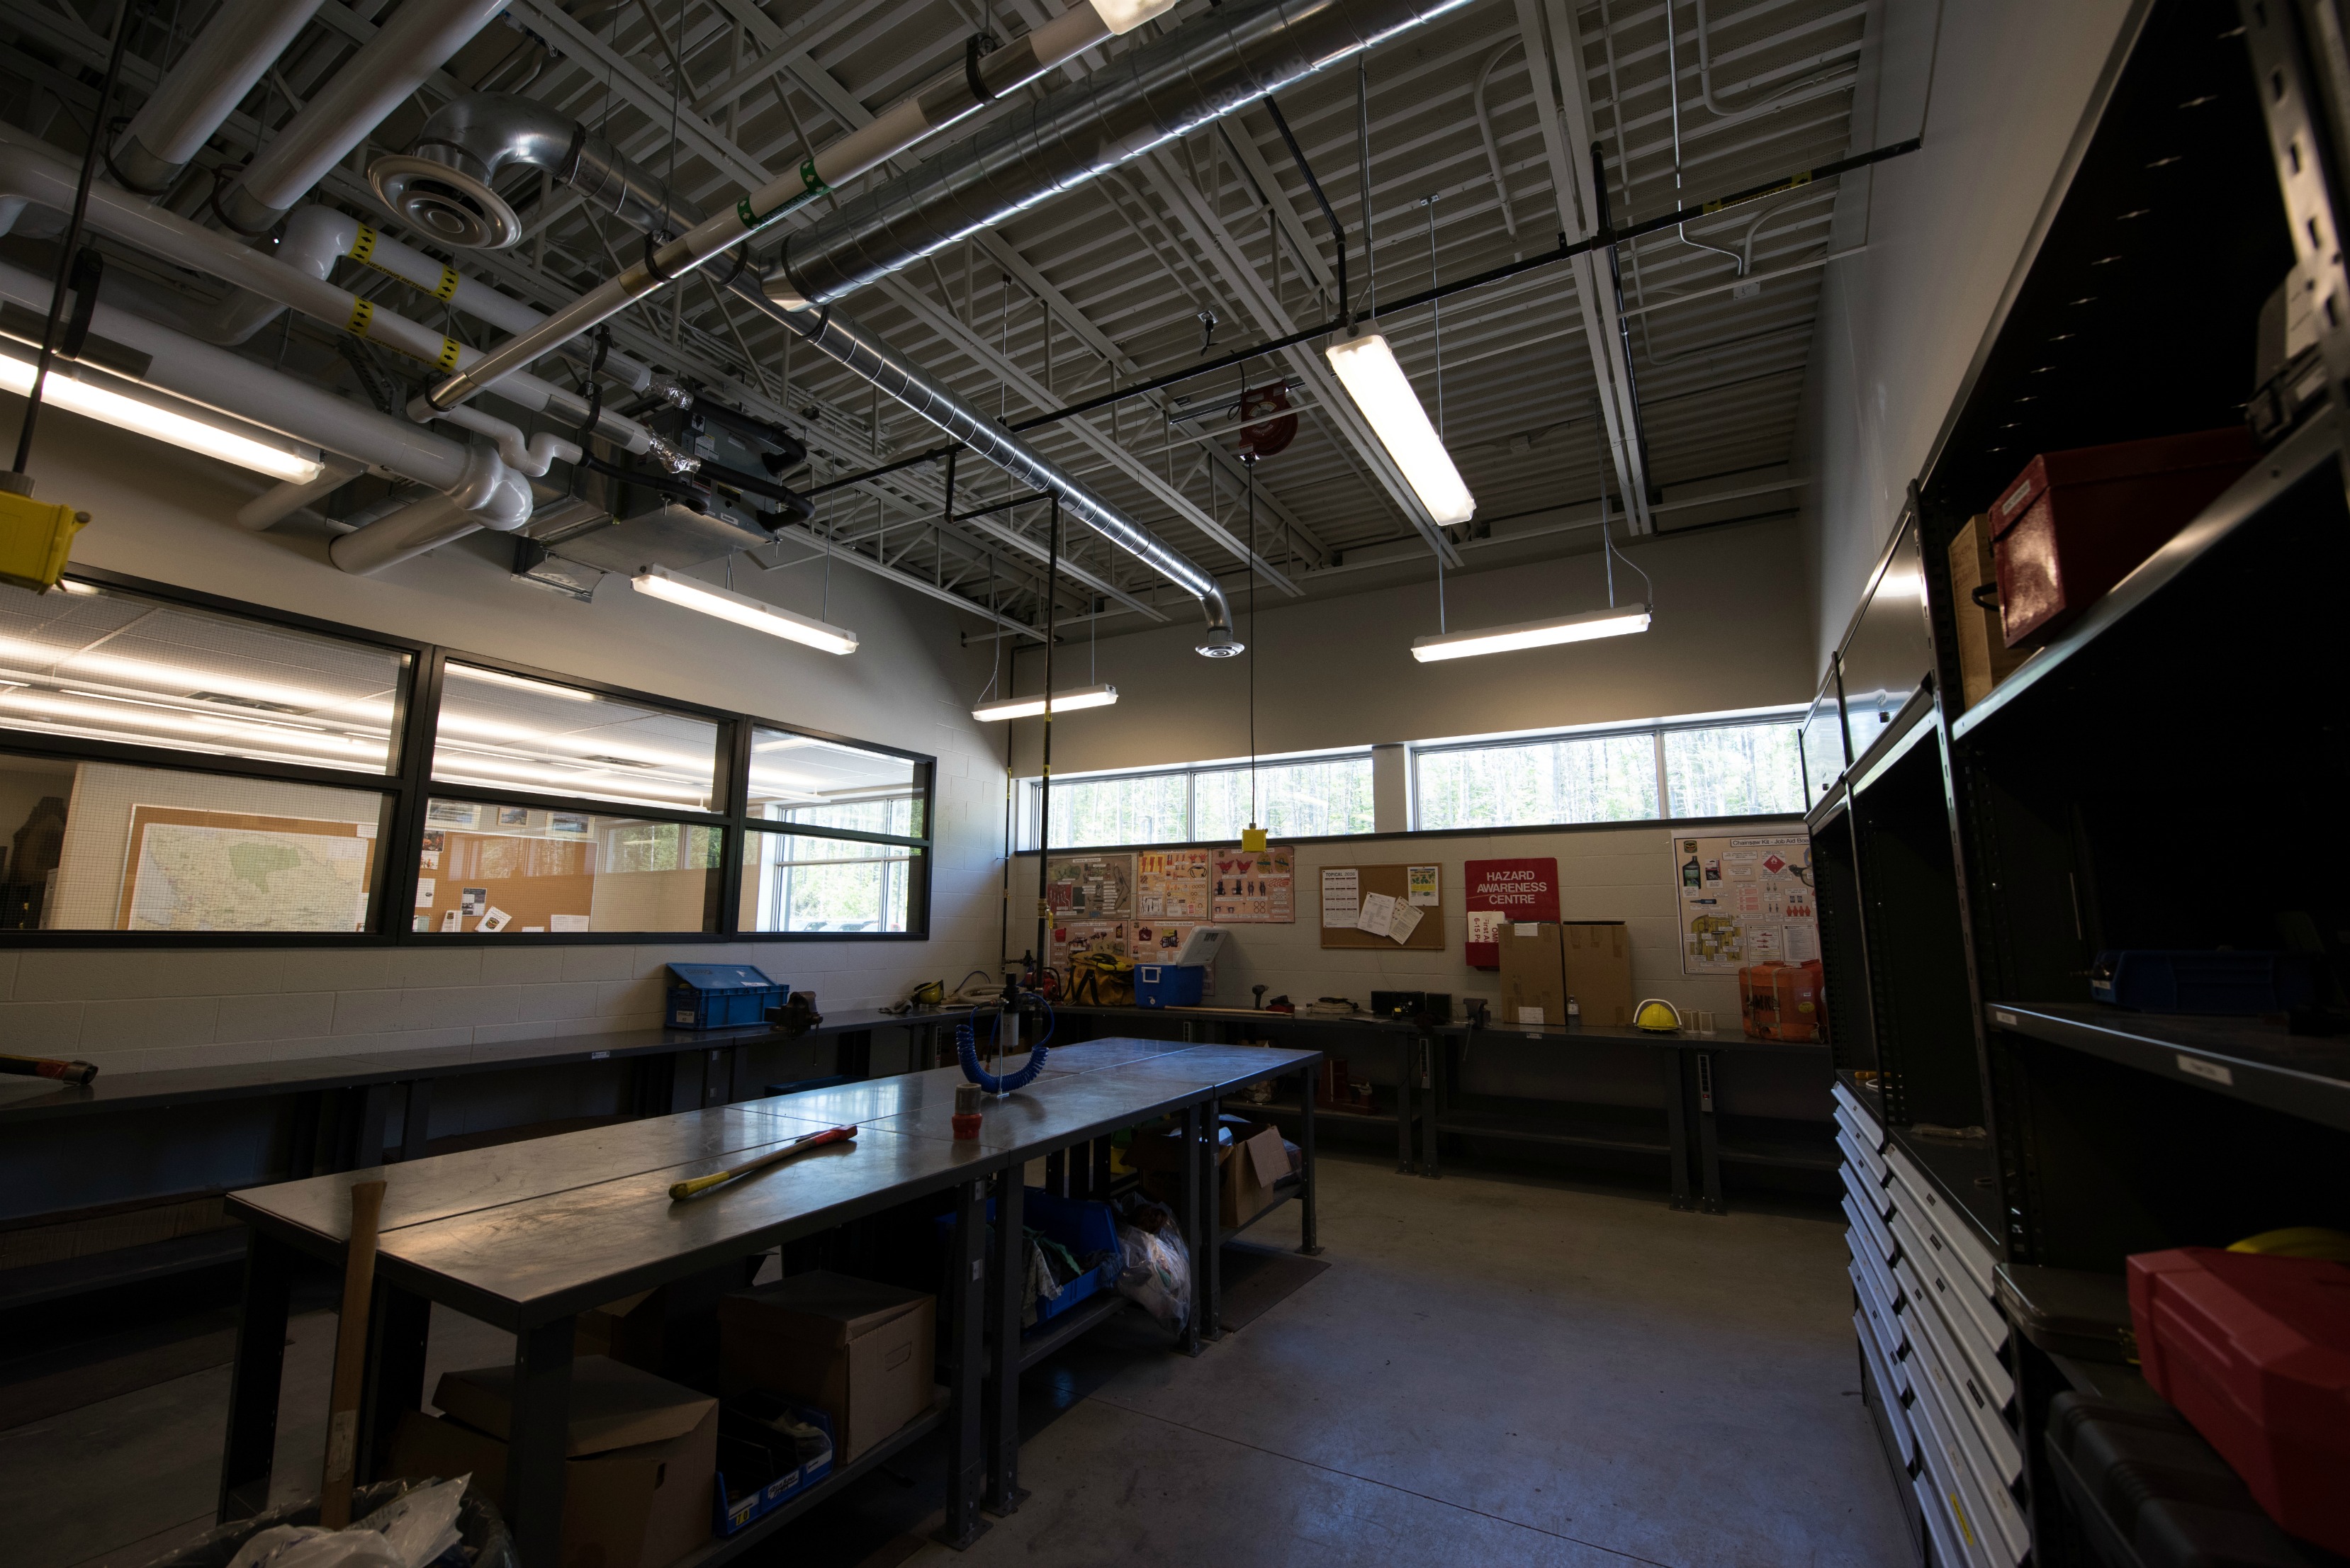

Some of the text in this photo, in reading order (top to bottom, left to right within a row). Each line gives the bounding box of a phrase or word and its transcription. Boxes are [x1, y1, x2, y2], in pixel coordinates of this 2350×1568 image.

[762, 191, 812, 223] CONDENSATE
[366, 261, 432, 295] HEATING RETURN
[364, 334, 401, 352] HEATING
[1486, 871, 1535, 881] HAZARD
[1477, 882, 1547, 893] AWARENESS
[1489, 894, 1536, 905] CENTRE
